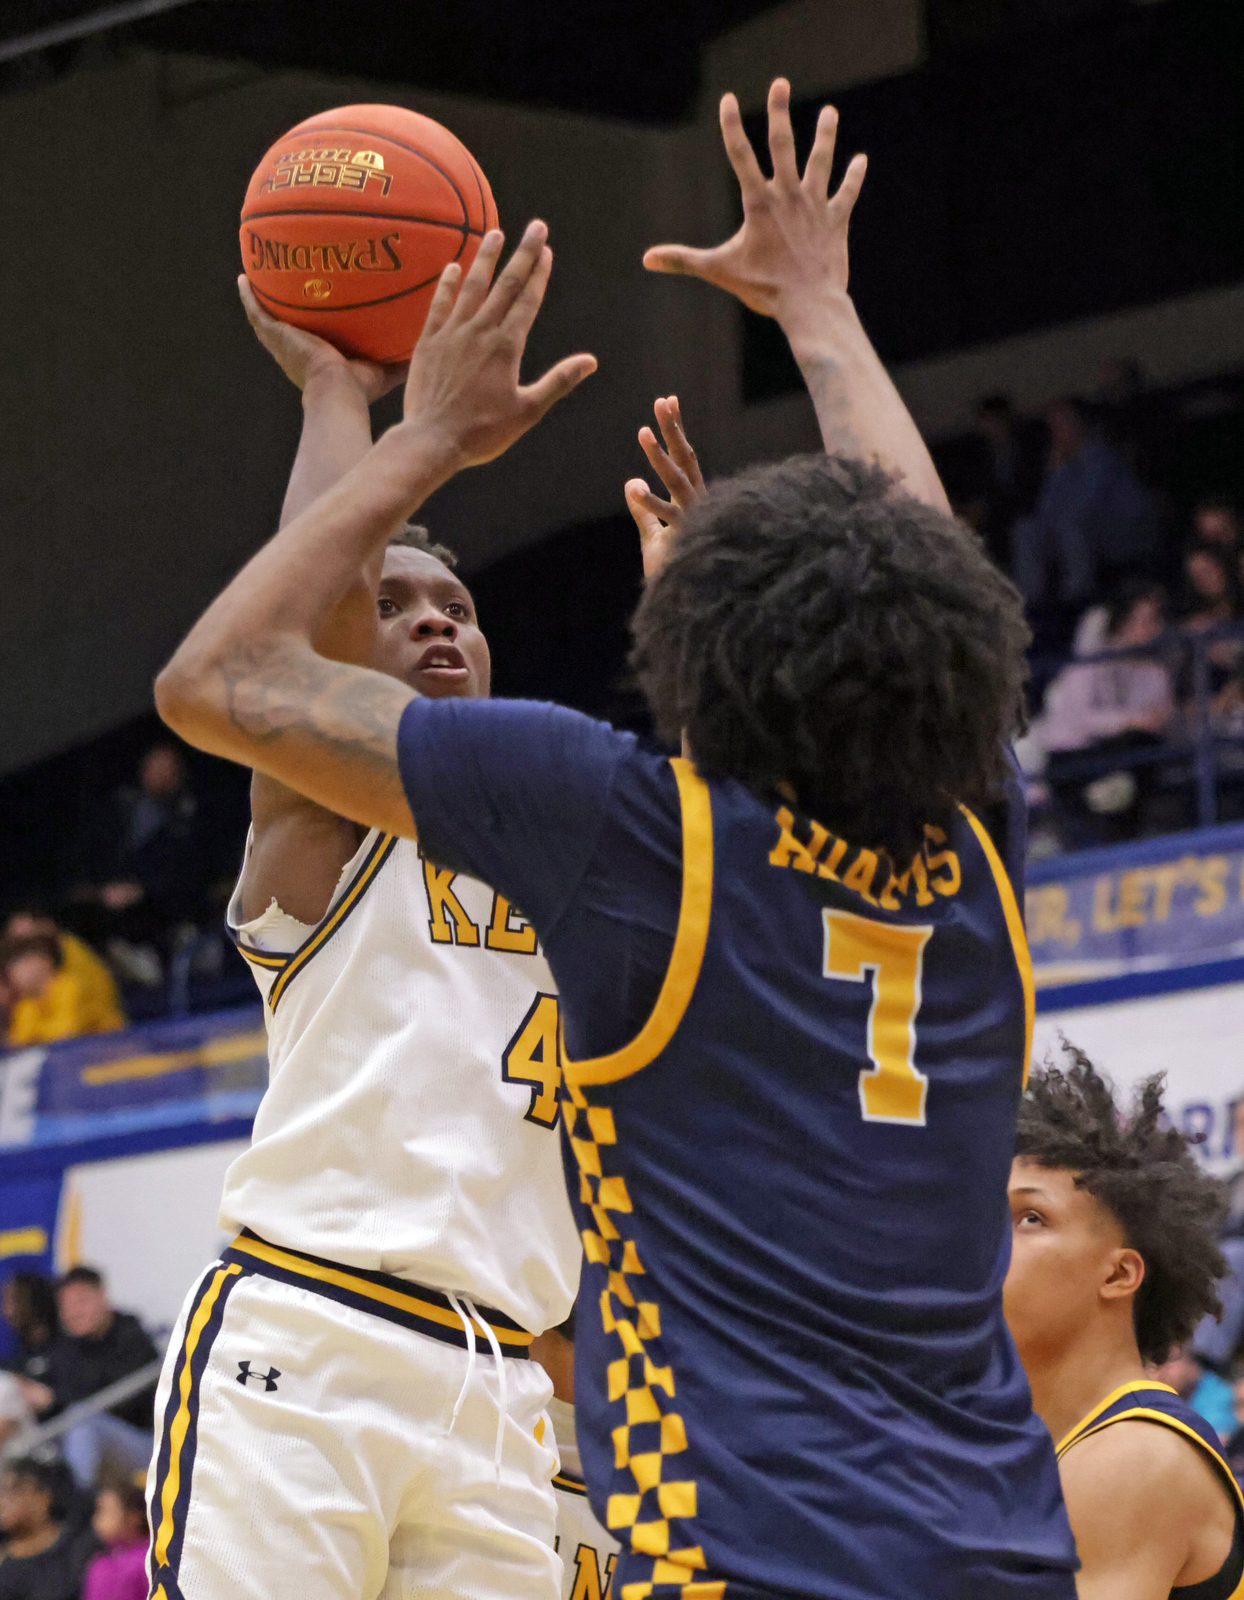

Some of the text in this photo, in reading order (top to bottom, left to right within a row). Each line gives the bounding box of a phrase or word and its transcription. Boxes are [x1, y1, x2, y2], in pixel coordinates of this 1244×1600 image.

[260, 163, 393, 197] LEGACY
[249, 230, 402, 273] SPALDING
[1093, 853, 1229, 932] LET'S
[822, 907, 934, 1127] 7
[501, 991, 561, 1131] 4
